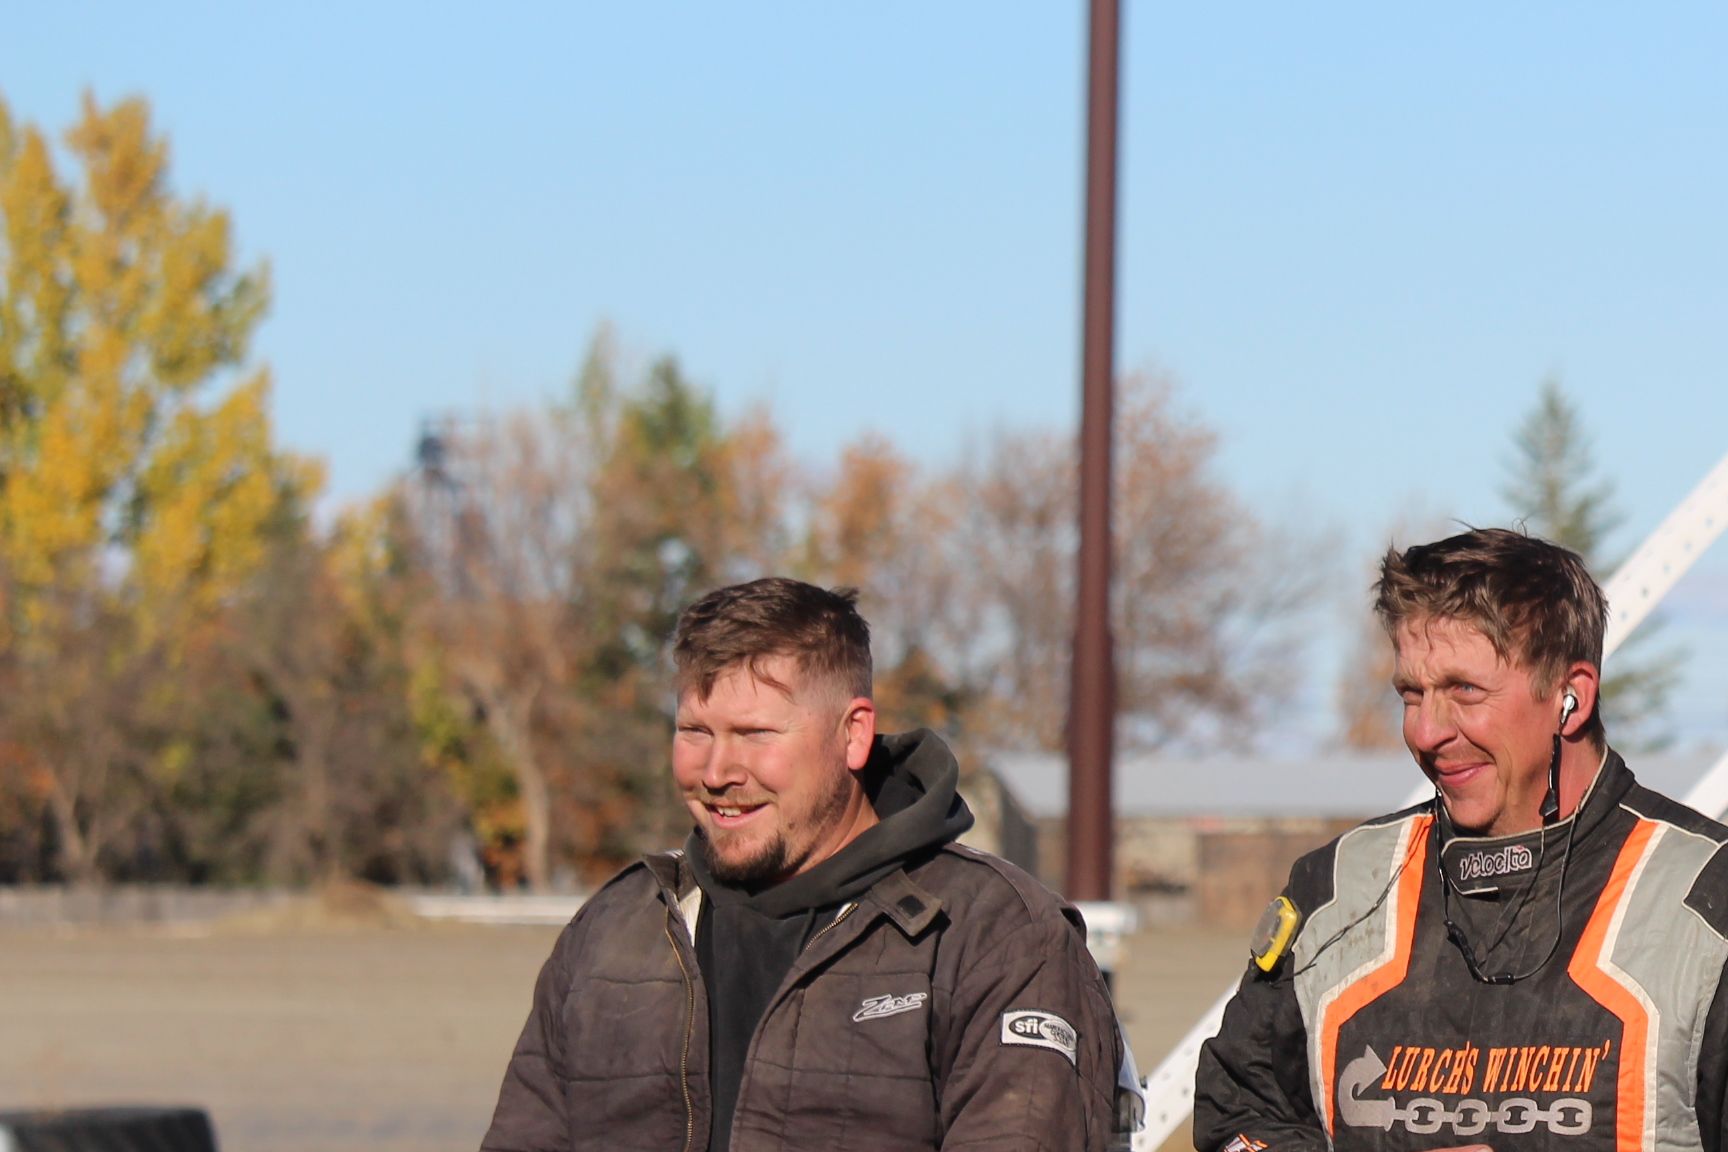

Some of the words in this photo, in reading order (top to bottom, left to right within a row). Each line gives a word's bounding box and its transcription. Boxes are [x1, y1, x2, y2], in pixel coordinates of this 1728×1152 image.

[1015, 1018, 1038, 1034] sfi
[1382, 1041, 1479, 1095] LURCH'S
[1483, 1039, 1611, 1093] WINCHIN'
